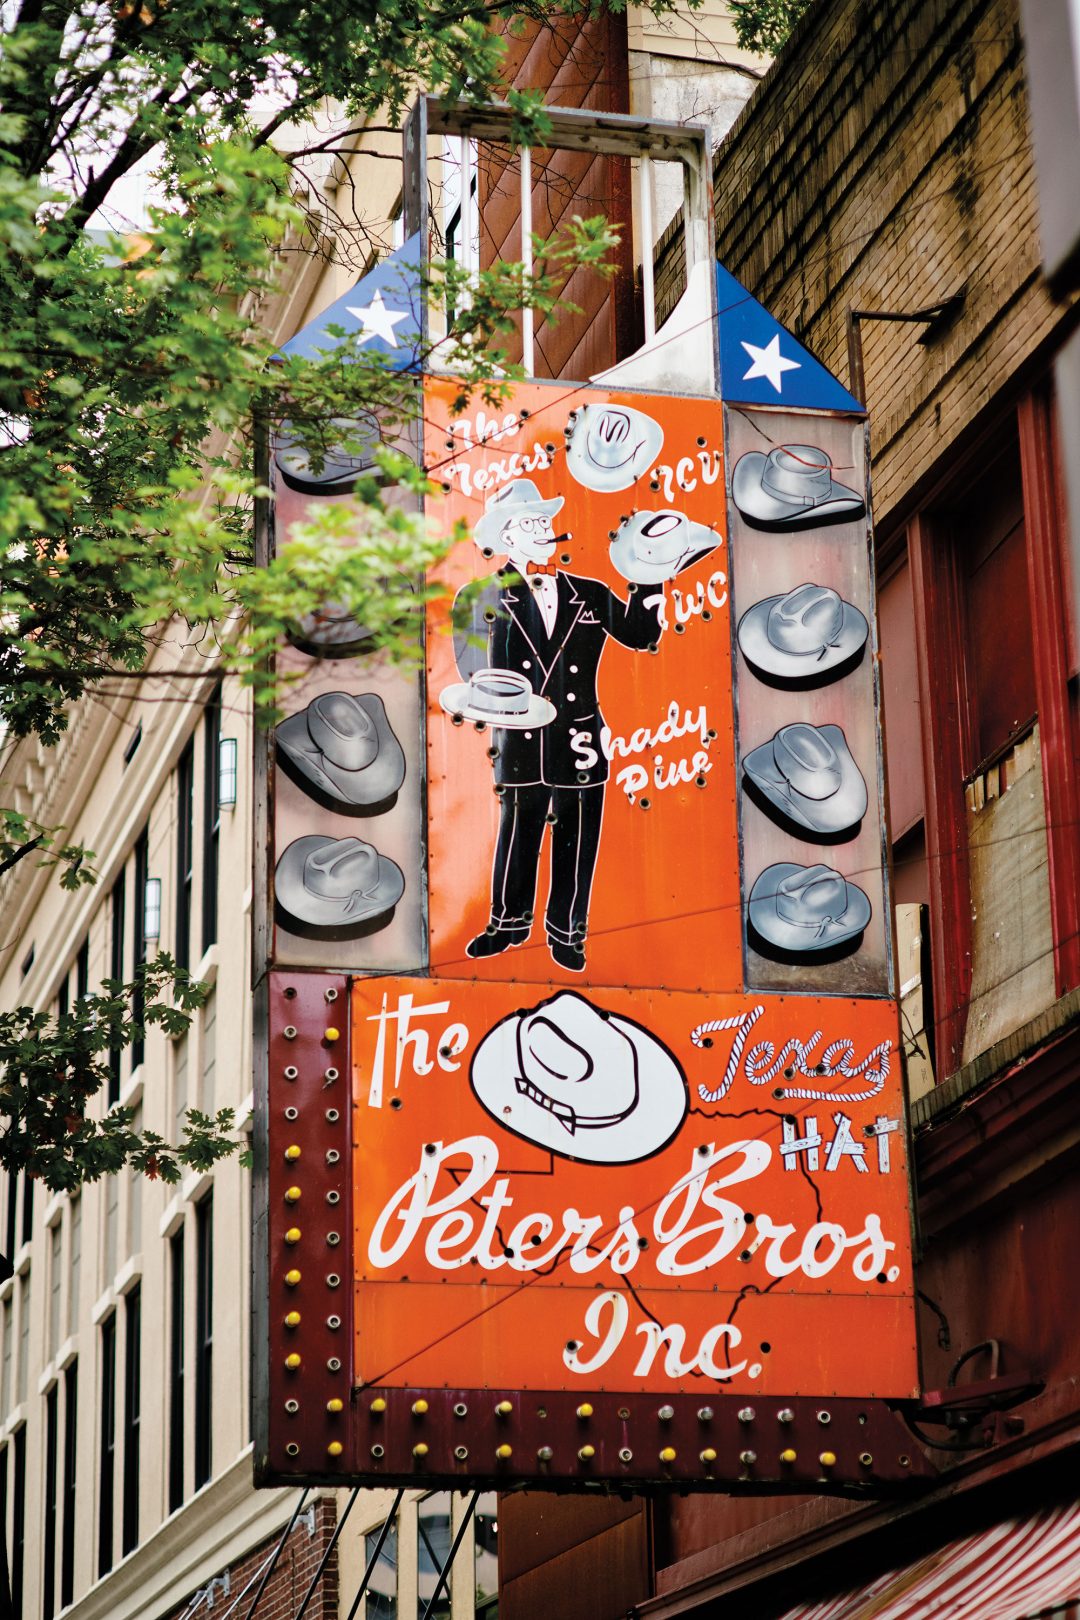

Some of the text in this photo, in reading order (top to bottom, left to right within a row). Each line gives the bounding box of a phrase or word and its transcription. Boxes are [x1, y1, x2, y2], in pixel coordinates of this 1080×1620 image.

[446, 411, 521, 452] The
[444, 442, 552, 496] Texas
[569, 700, 710, 770] Shady
[691, 1005, 893, 1103] Texas
[779, 1111, 900, 1174] HAT
[367, 1135, 900, 1283] Peters Bros.
[562, 1291, 762, 1379] Inc.
